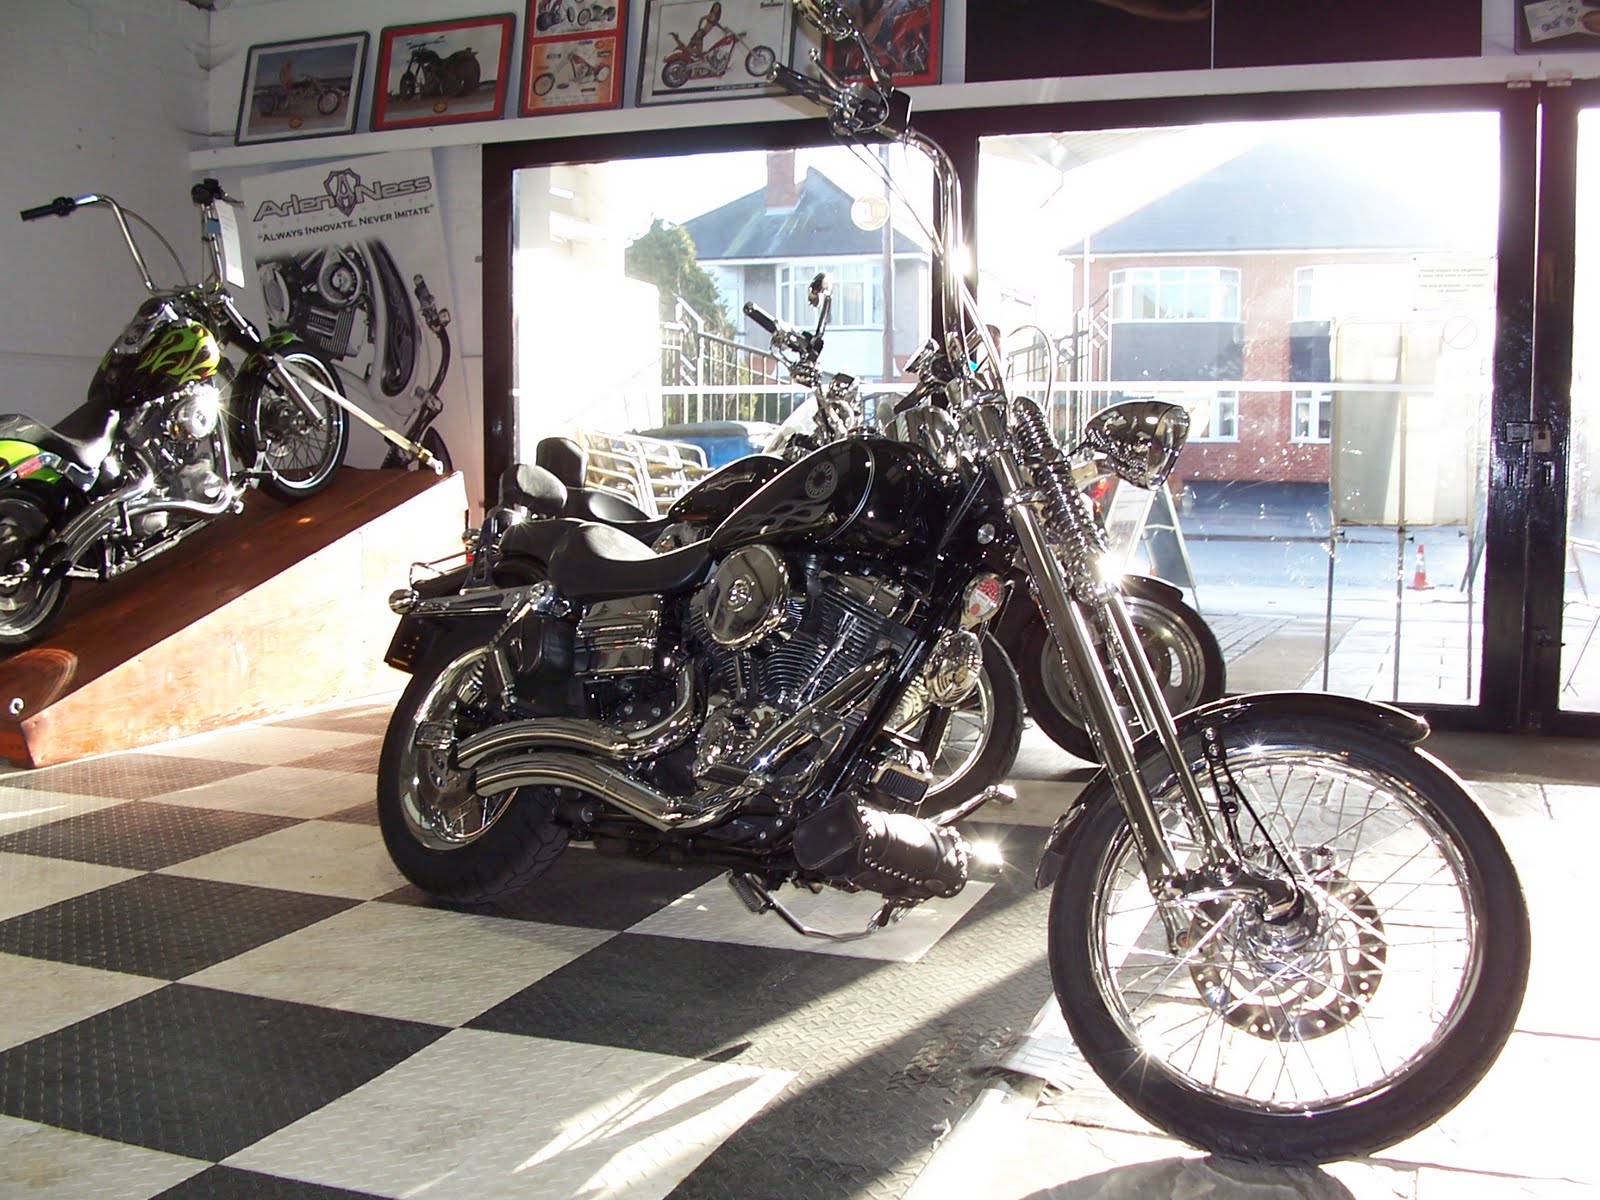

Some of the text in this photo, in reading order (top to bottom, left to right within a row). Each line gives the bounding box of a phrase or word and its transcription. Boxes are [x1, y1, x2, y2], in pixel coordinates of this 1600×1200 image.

[253, 194, 336, 222] Arlen
[354, 176, 432, 204] Ness
[359, 213, 393, 226] NEVER
